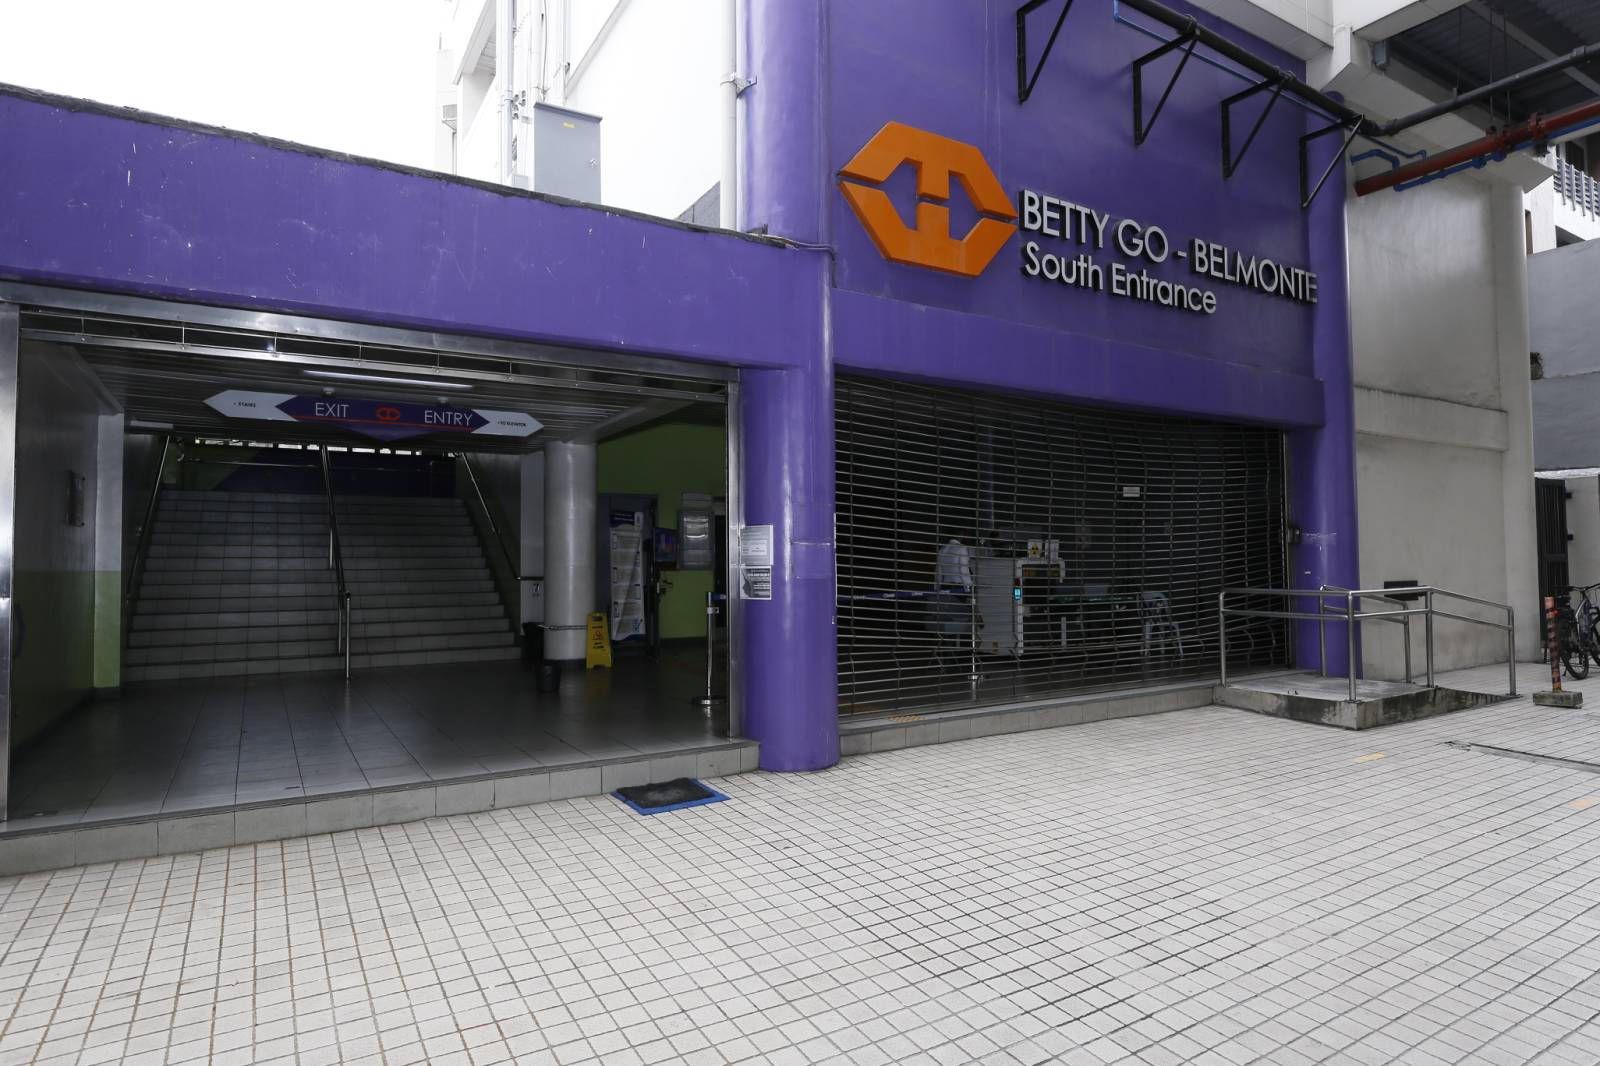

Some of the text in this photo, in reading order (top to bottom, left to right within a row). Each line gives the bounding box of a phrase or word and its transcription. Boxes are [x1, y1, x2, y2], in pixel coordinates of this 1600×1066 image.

[1023, 189, 1110, 249] BETTY
[1117, 218, 1169, 264] GO
[1194, 237, 1318, 303] BELMONTE
[1024, 240, 1217, 314] South Entrance
[315, 402, 350, 418] EXIT
[424, 409, 473, 426] ENTRY
